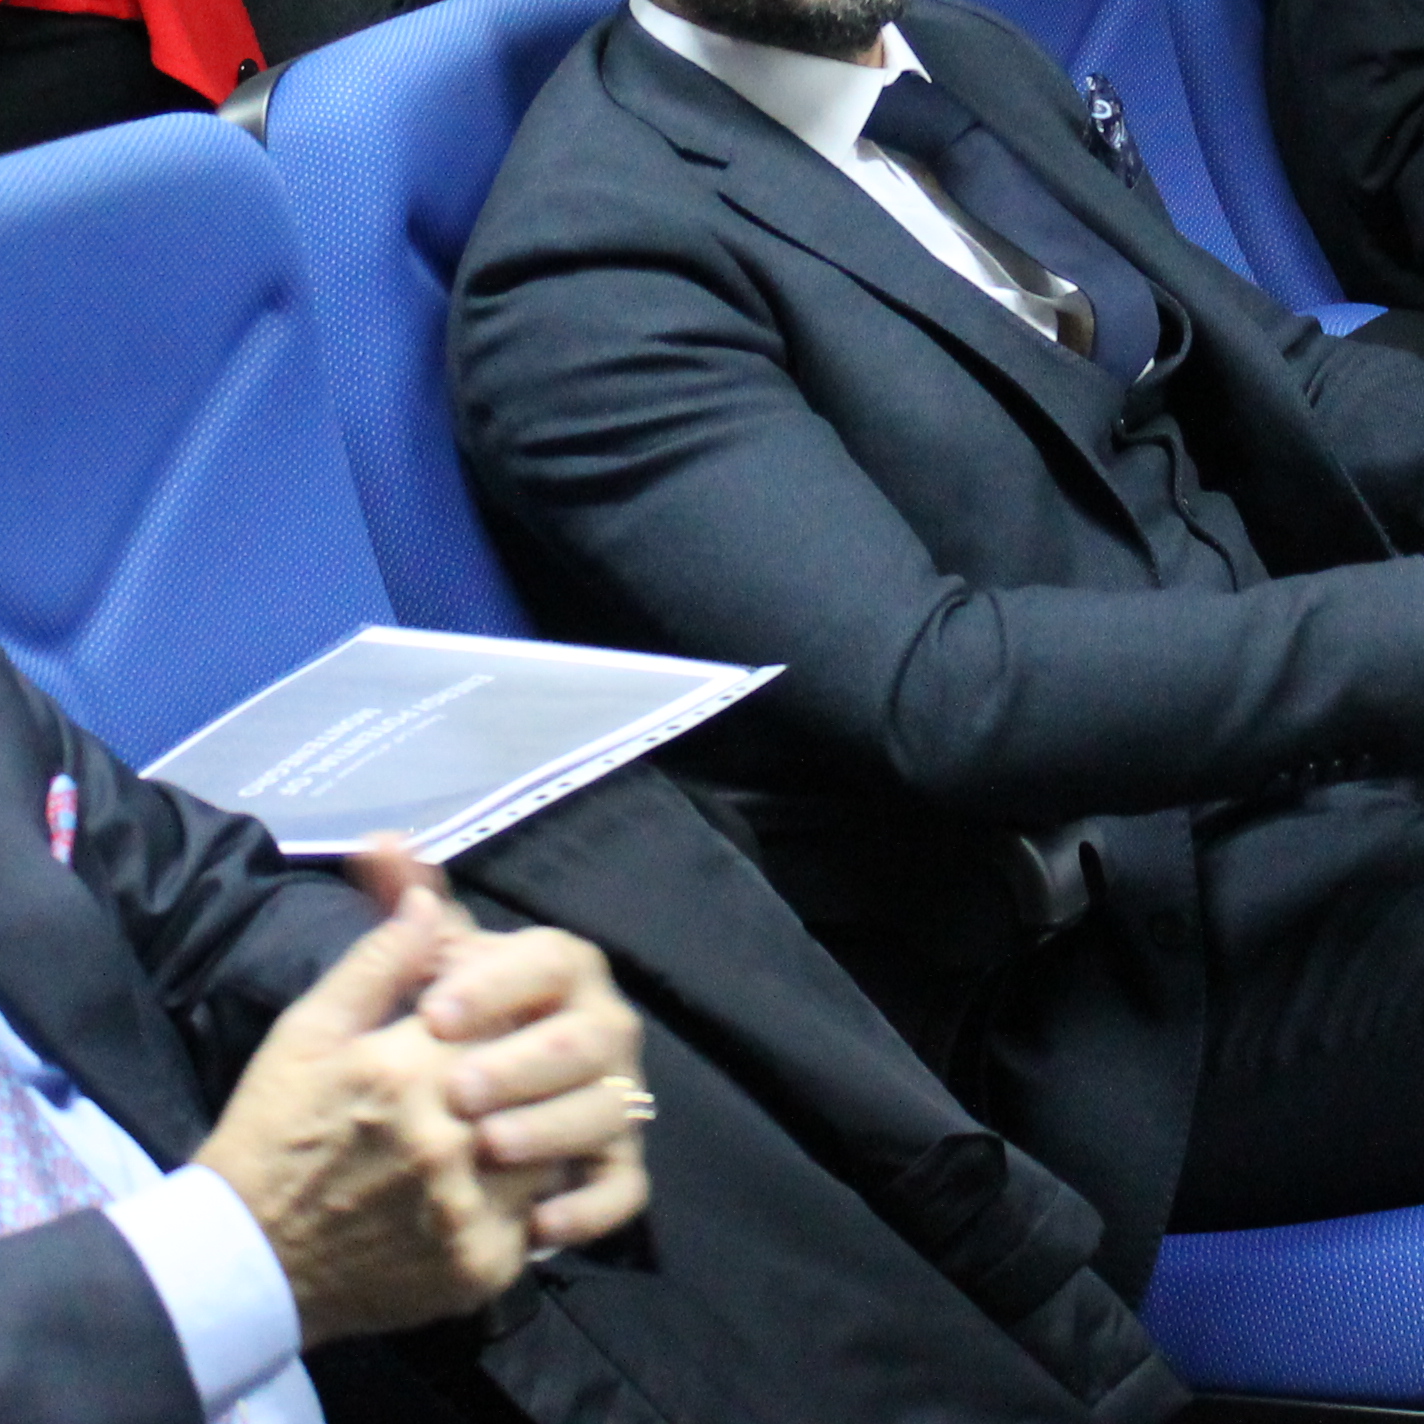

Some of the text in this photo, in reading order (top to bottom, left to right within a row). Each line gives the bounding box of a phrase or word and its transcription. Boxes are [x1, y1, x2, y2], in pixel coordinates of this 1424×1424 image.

[237, 707, 383, 798] MONTENEGRO
[303, 709, 420, 775] POTENTIAL
[278, 776, 313, 797] OF
